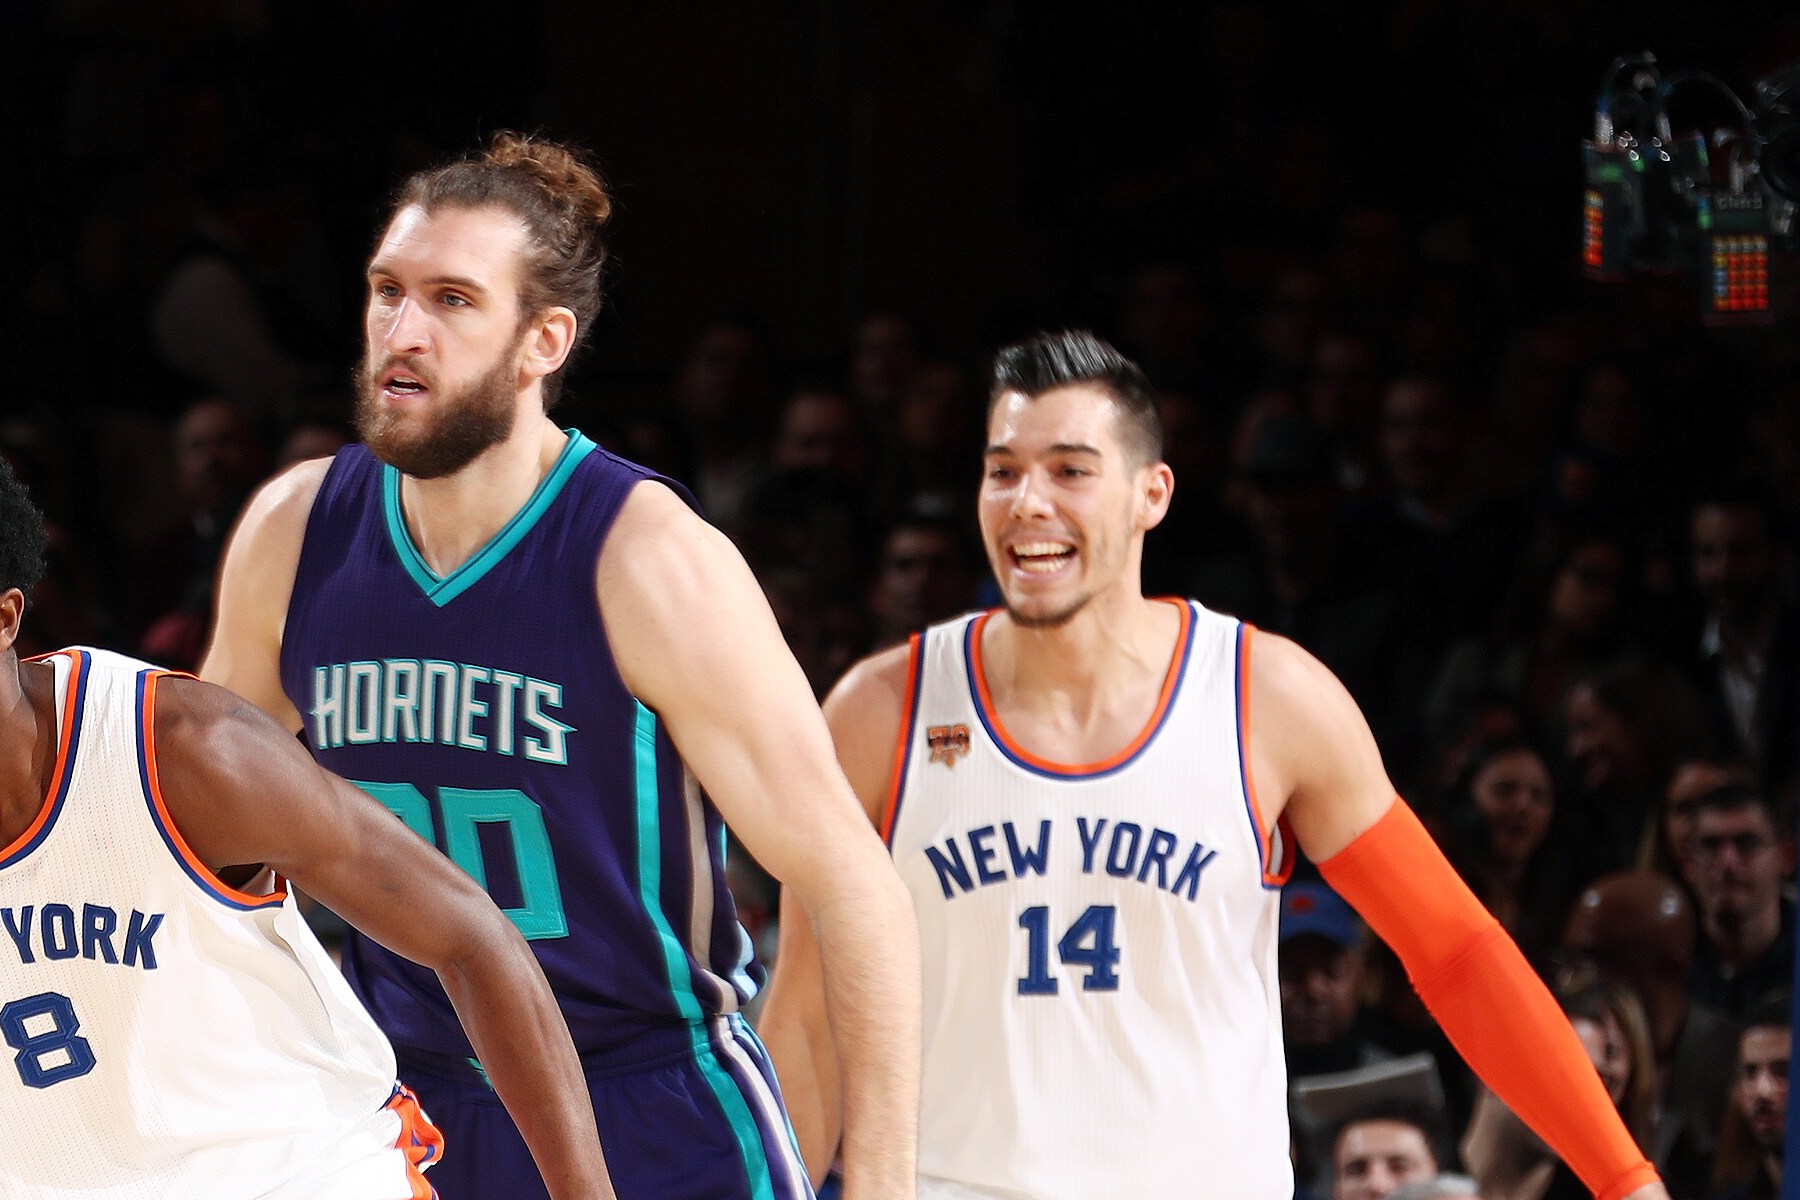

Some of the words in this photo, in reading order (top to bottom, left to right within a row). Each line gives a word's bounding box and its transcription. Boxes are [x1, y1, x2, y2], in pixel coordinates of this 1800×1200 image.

[310, 658, 578, 766] HORNETS
[924, 819, 1053, 901] NEW
[1076, 817, 1219, 902] YORK
[0, 902, 166, 971] YORK
[1018, 905, 1121, 996] 14
